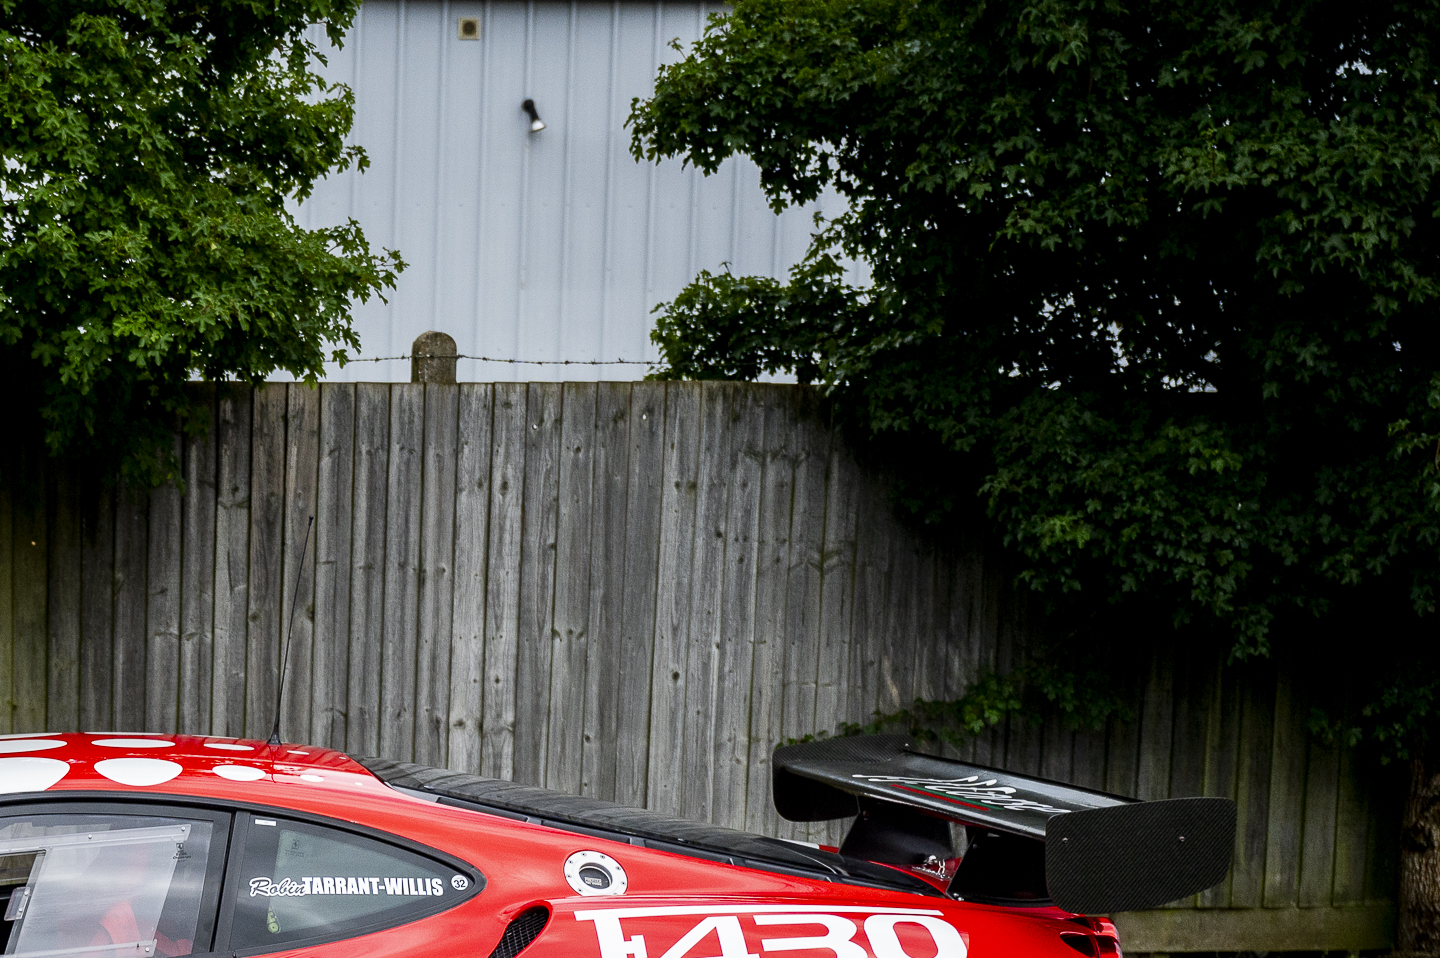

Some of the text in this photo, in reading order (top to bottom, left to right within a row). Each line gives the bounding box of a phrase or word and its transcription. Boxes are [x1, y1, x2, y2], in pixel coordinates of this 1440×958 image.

[249, 876, 444, 897] Robin TARRANT-WILLIS
[453, 879, 466, 888] 32
